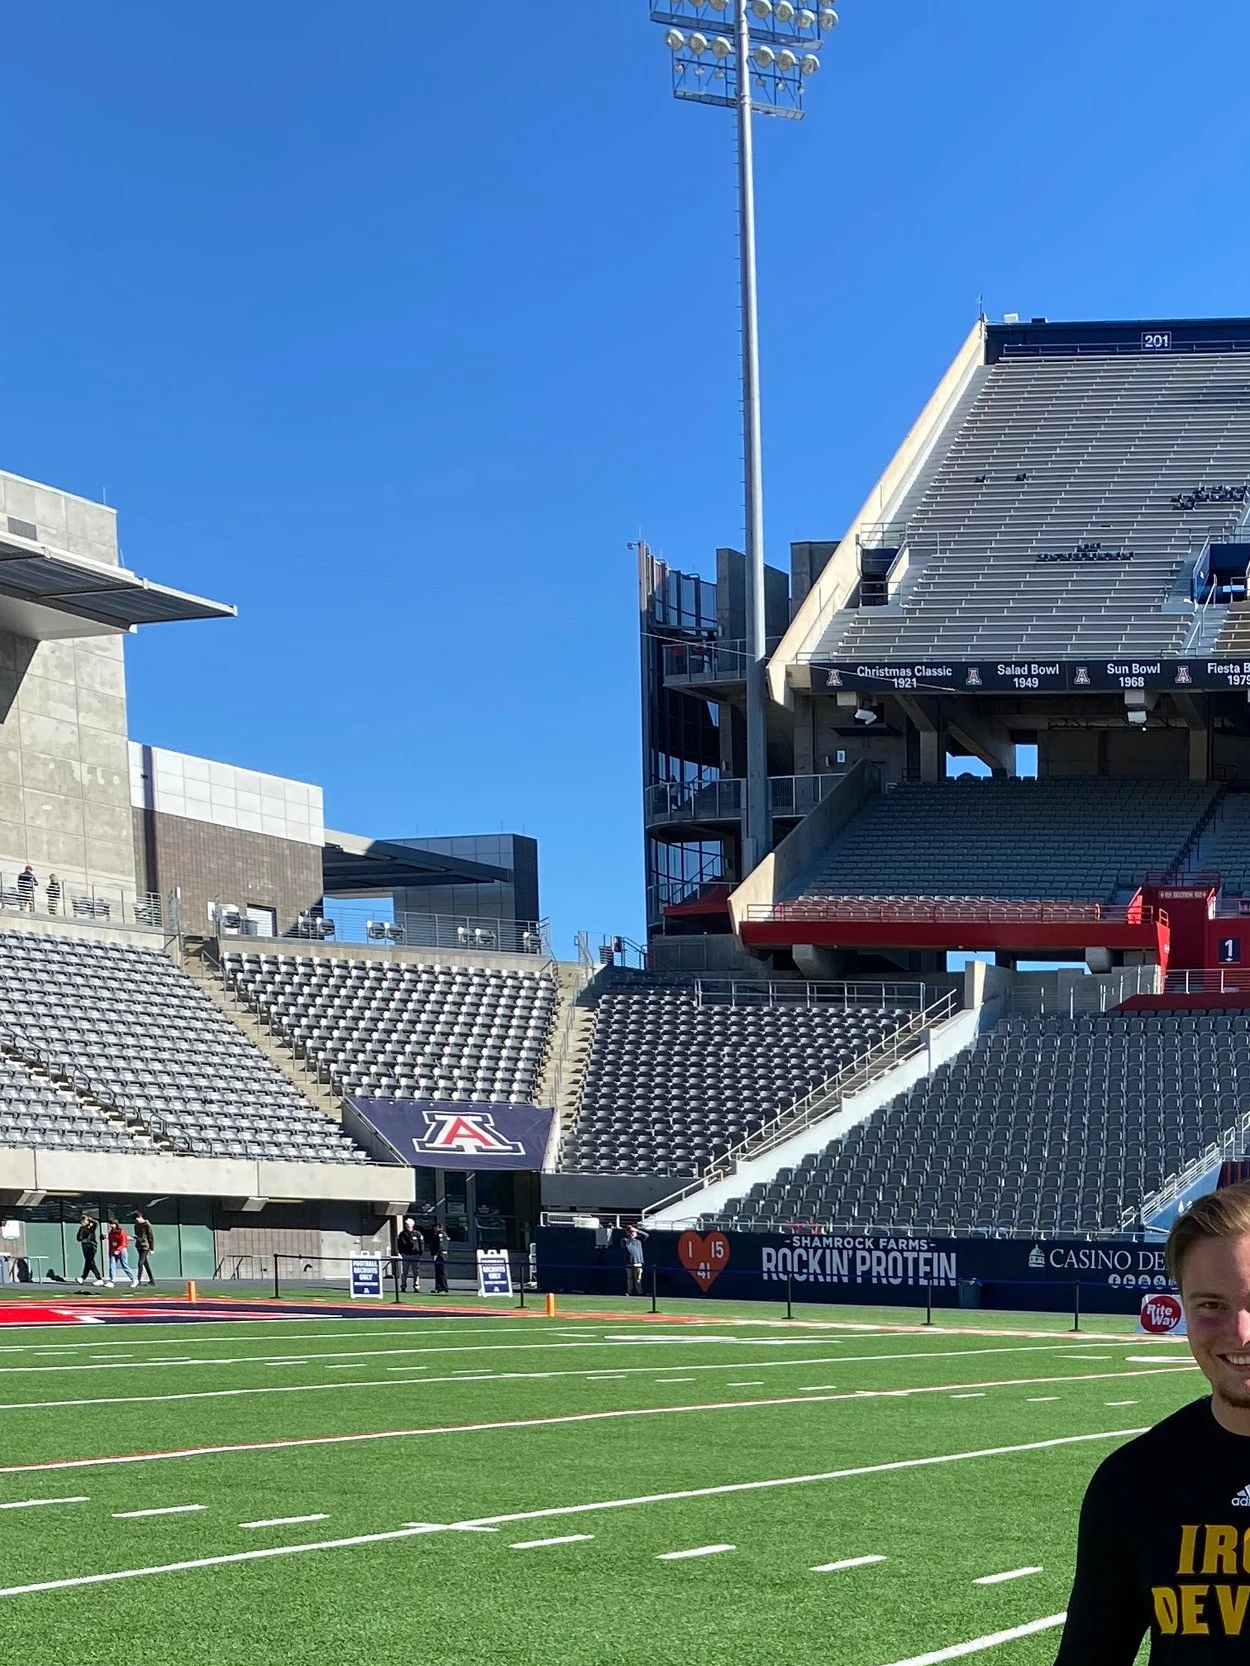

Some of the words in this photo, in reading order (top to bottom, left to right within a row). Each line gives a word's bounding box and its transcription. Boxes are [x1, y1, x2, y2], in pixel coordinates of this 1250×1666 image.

[1144, 334, 1169, 348] 201
[856, 666, 912, 677] Christmas
[914, 665, 953, 677] Classic
[997, 664, 1028, 675] Salad
[1031, 663, 1060, 675] Bowl
[1106, 663, 1129, 674] Sun
[1132, 662, 1161, 674] Bowl
[1207, 662, 1241, 674] Fiesta
[893, 677, 917, 689] 1921
[1013, 677, 1039, 688] 1949
[1118, 676, 1145, 688] 1968
[1224, 939, 1234, 957] 1
[687, 1240, 693, 1259] 1
[711, 1241, 725, 1259] 15
[792, 1236, 875, 1249] SHAMROCK
[879, 1238, 928, 1251] FARMS
[1049, 1248, 1132, 1271] CASINO
[1138, 1251, 1168, 1271] DE
[697, 1262, 711, 1280] 41
[762, 1246, 853, 1283] ROCKIN'
[856, 1250, 958, 1287] PROTEIN
[1146, 1303, 1173, 1316] Rite
[1151, 1312, 1178, 1328] Way
